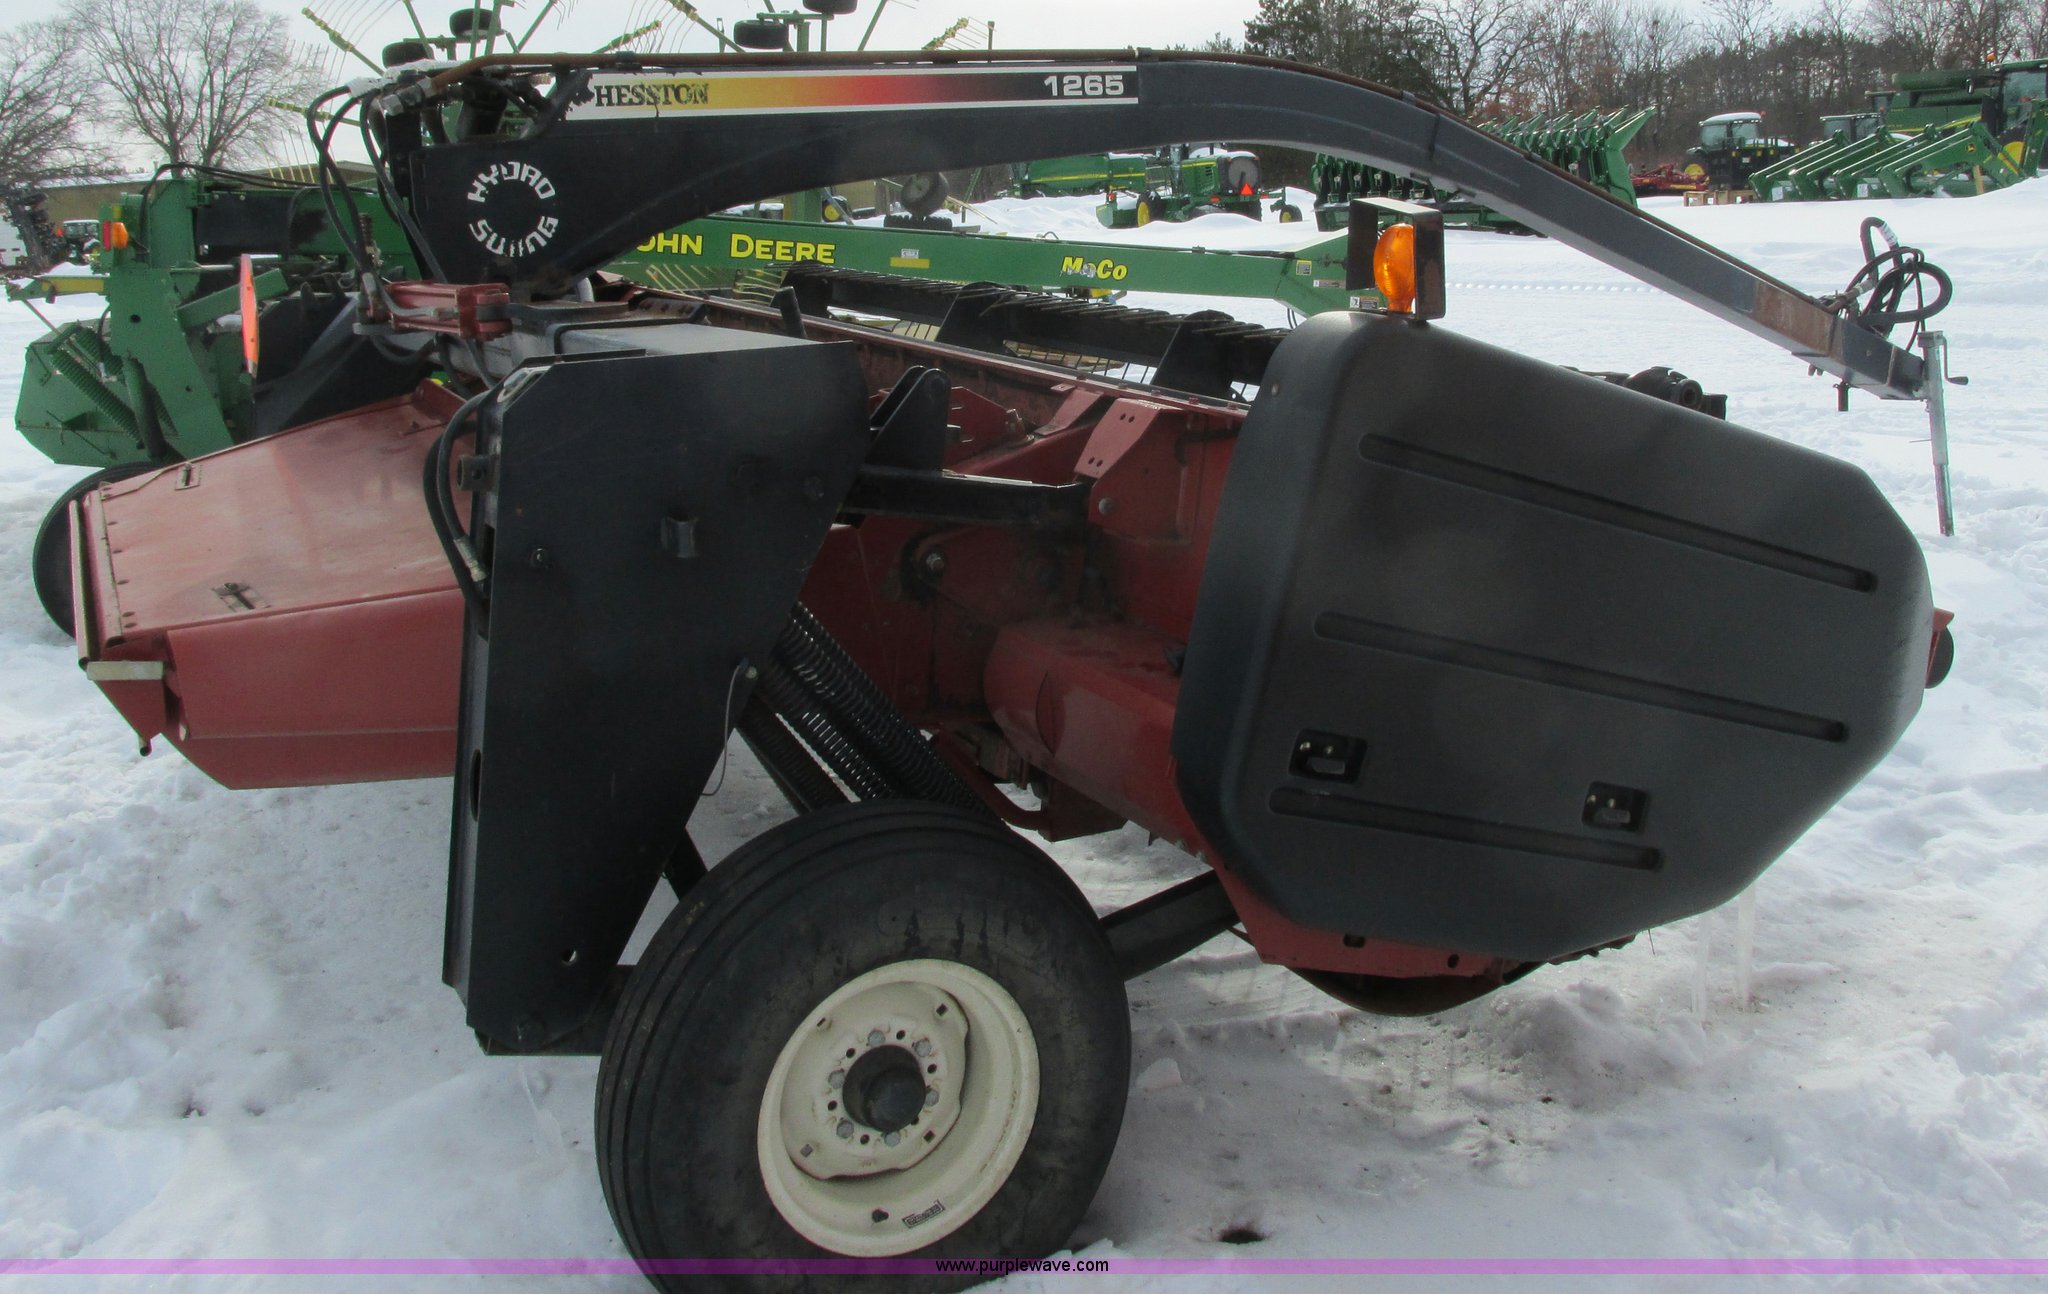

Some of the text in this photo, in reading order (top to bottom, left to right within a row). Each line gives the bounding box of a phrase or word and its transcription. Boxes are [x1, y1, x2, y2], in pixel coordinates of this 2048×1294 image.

[594, 83, 709, 107] HESSTON
[1044, 74, 1124, 96] 1265
[467, 161, 556, 202] HYDRO
[730, 233, 836, 264] DEERE
